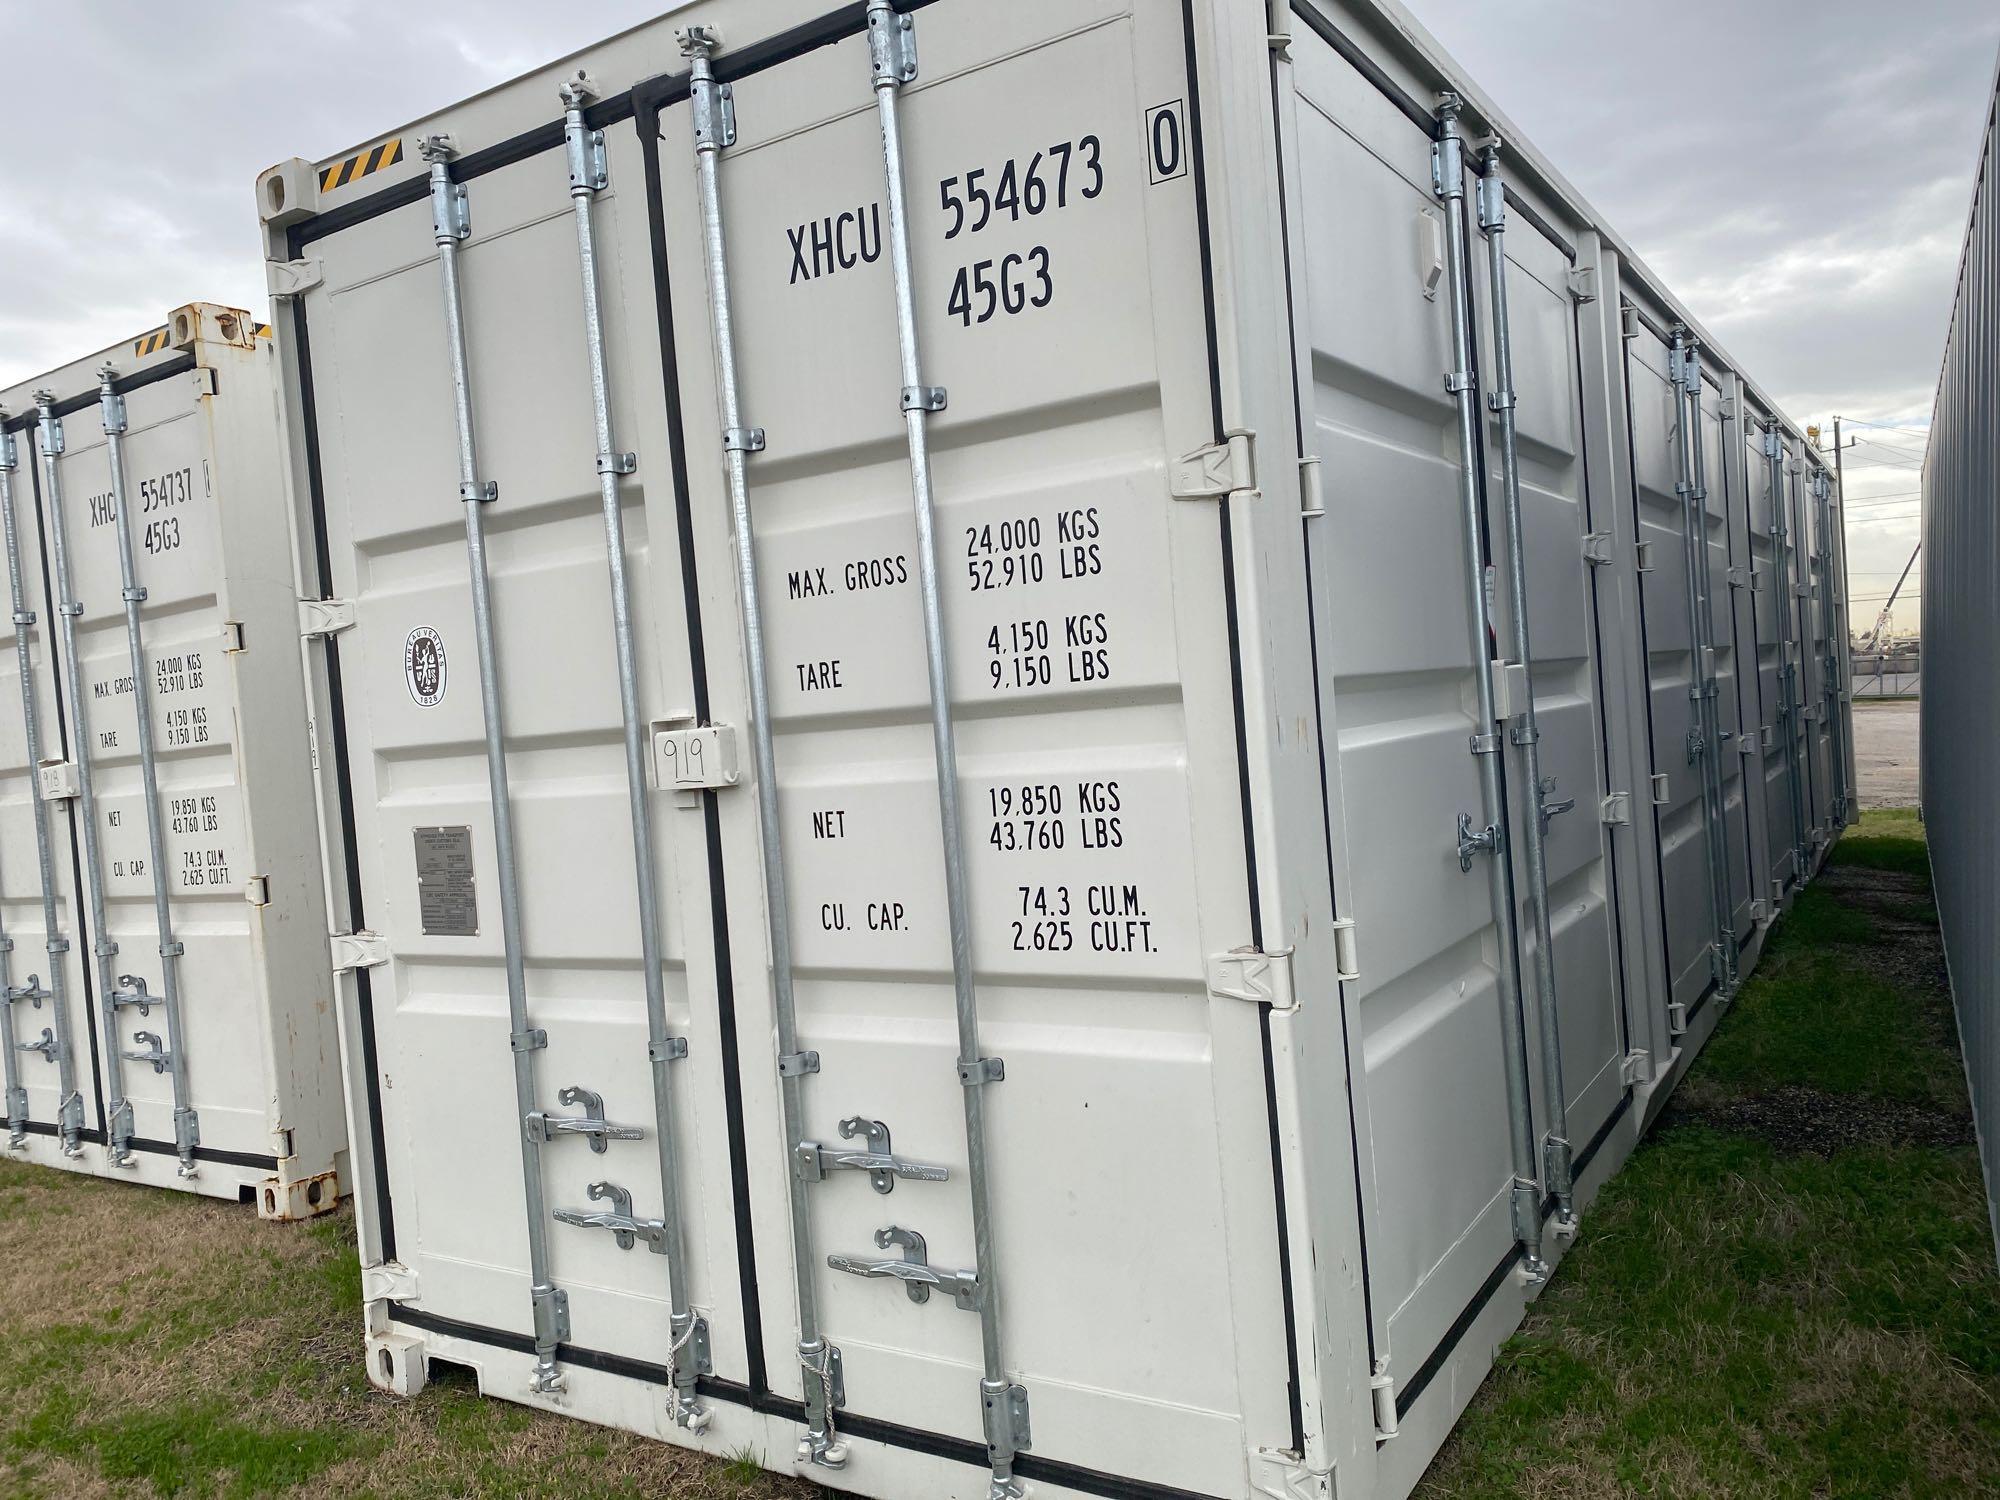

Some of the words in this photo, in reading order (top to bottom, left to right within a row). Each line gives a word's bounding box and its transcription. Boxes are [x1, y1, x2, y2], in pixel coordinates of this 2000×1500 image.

[787, 203, 881, 284] XHCU
[940, 135, 1103, 239] 554673
[1152, 109, 1180, 175] 0
[948, 246, 1052, 327] 45G3
[89, 492, 116, 527] XHC
[140, 468, 192, 512] 554737
[145, 517, 180, 554] 45G3
[1058, 508, 1099, 543] KGS
[1060, 544, 1101, 579] LBS
[788, 568, 835, 600] MAX.
[845, 555, 907, 591] GROSS
[1066, 613, 1107, 647] KGS
[186, 653, 202, 671] KGS
[797, 660, 842, 691] TARE
[1068, 649, 1109, 682] LBS
[94, 681, 112, 698] MAX.
[114, 676, 135, 694] GROS
[189, 672, 203, 689] LBS
[192, 707, 207, 724] KGS
[100, 731, 118, 748] TARE
[194, 725, 209, 742] LBS
[201, 796, 216, 813] KGS
[1079, 782, 1120, 813] KGS
[108, 811, 121, 827] NET
[202, 814, 218, 831] LBS
[813, 811, 845, 838] NET
[1081, 817, 1122, 848] LBS
[113, 862, 126, 877] CU.
[130, 861, 147, 876] CAP.
[184, 851, 202, 867] 74.3
[1019, 886, 1070, 916] 74.3
[1088, 885, 1146, 916] CU.M.
[822, 904, 850, 931] CU.
[868, 903, 908, 931] CAP.
[1091, 921, 1158, 952] CU.FT.
